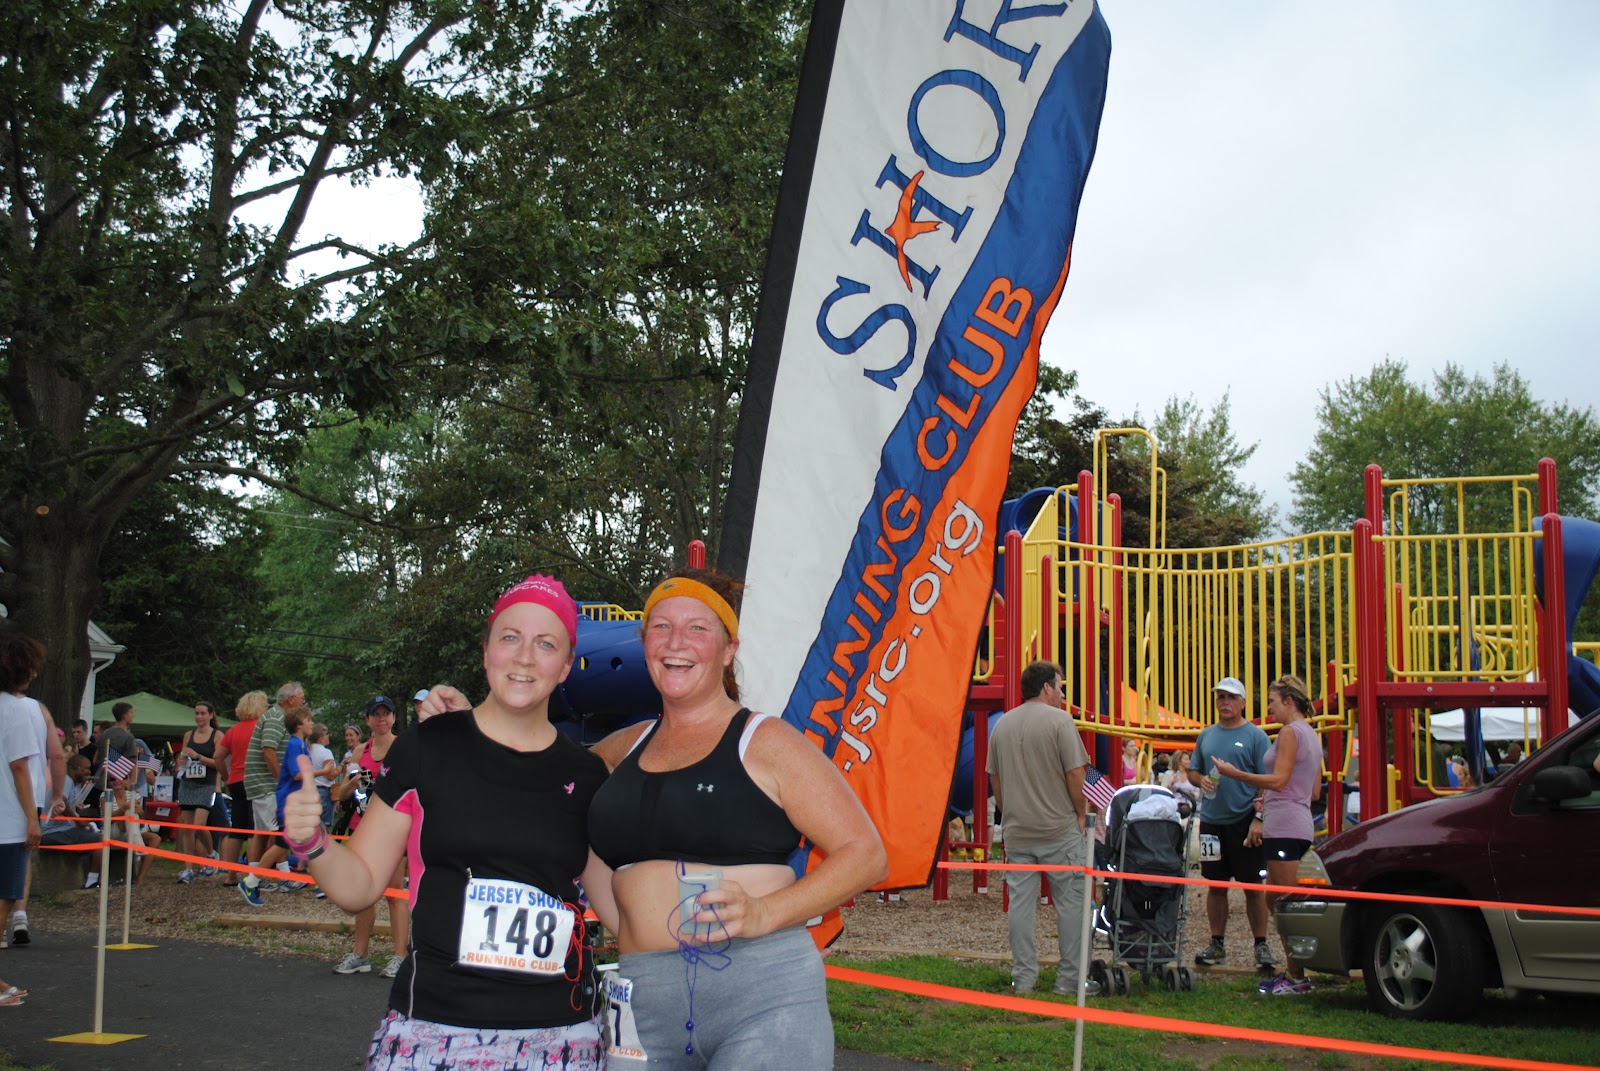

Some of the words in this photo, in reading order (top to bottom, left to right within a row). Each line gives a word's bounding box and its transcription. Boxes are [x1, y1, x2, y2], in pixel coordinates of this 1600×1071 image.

[915, 276, 1034, 471] CLUB
[189, 765, 203, 775] 116
[469, 884, 523, 904] JERSEY
[479, 904, 558, 959] 148
[466, 951, 526, 968] RUNNING
[530, 959, 559, 972] CLUB
[608, 980, 631, 1004] SHORE
